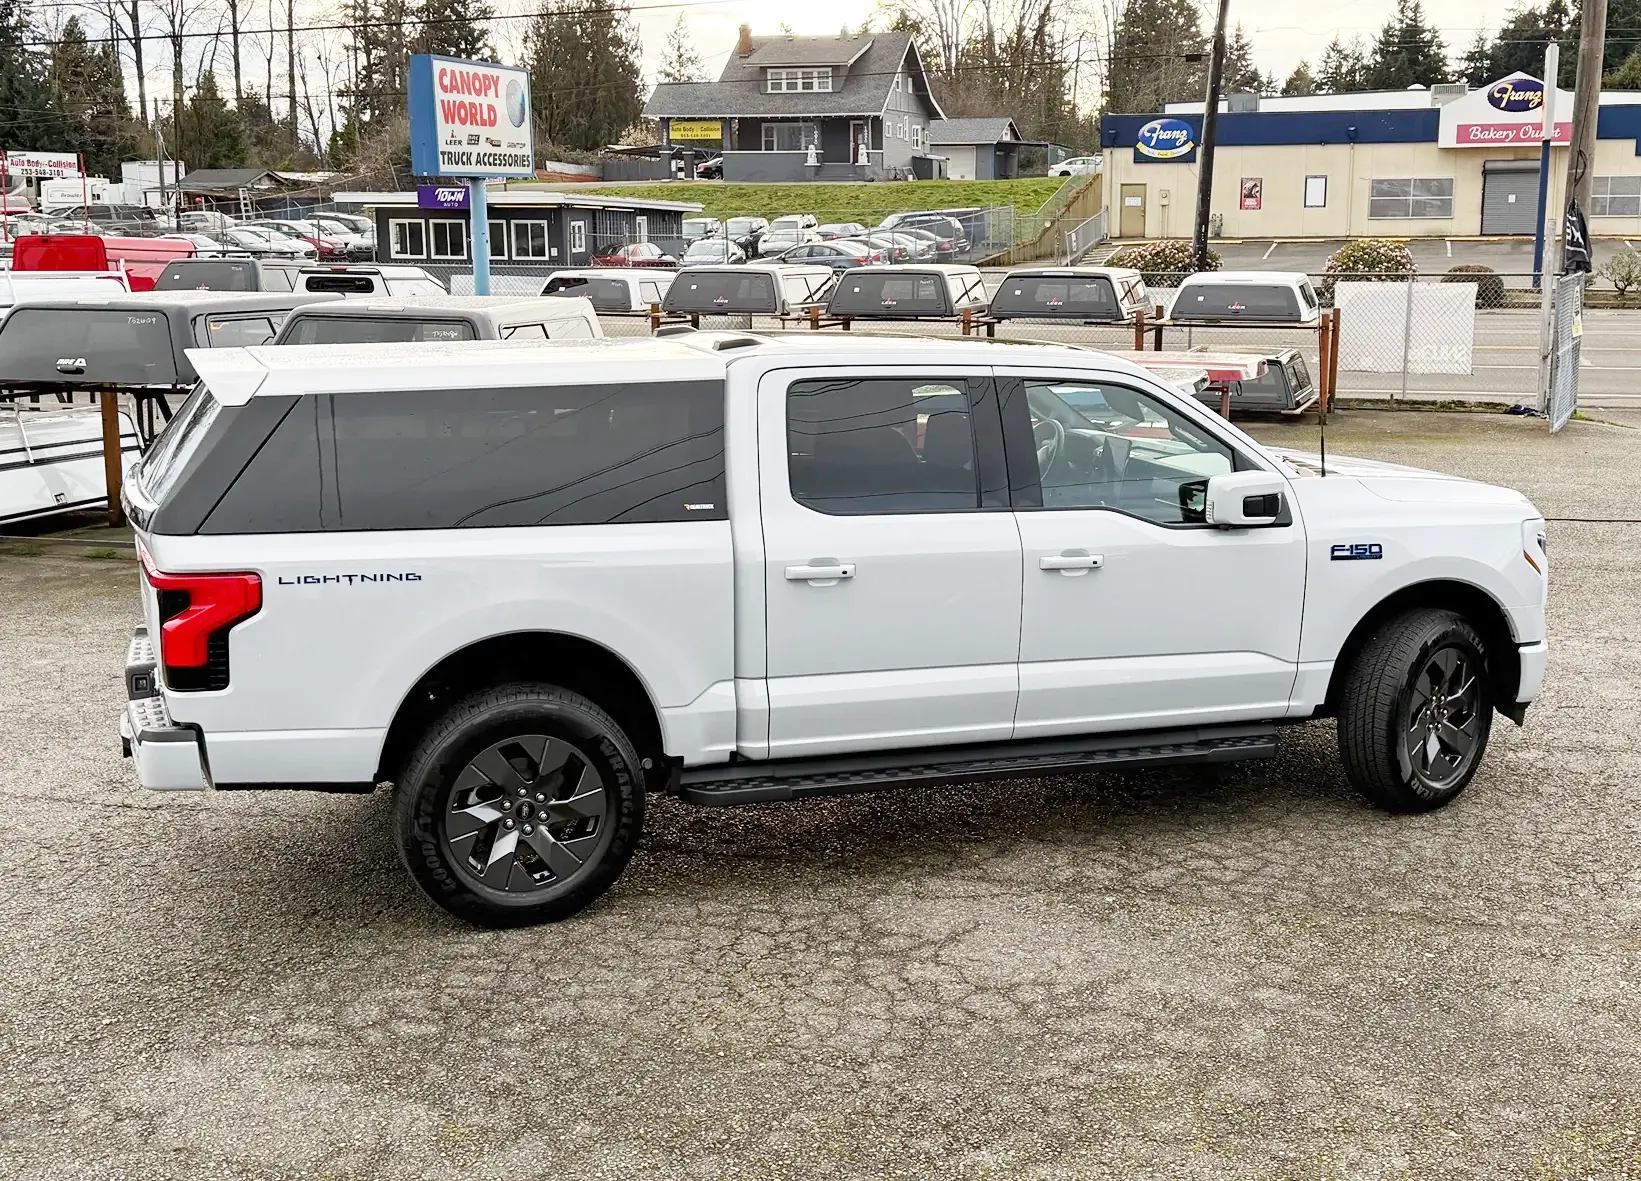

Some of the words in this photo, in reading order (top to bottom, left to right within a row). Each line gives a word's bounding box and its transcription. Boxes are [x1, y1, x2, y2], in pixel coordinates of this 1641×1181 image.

[438, 67, 500, 98] CANOPY
[1493, 82, 1543, 108] Franz
[439, 99, 498, 128] WORLD
[1143, 123, 1188, 147] Franz
[1468, 126, 1517, 142] Bakery
[1520, 125, 1561, 139] Out
[10, 158, 25, 167] Auto
[26, 159, 42, 168] Body
[48, 160, 76, 169] Collision
[439, 150, 473, 166] TRUCK
[475, 152, 531, 168] ACCESSORIES
[434, 187, 466, 202] TOWN
[1330, 543, 1383, 556] F-150
[278, 572, 422, 586] LIGHTNING
